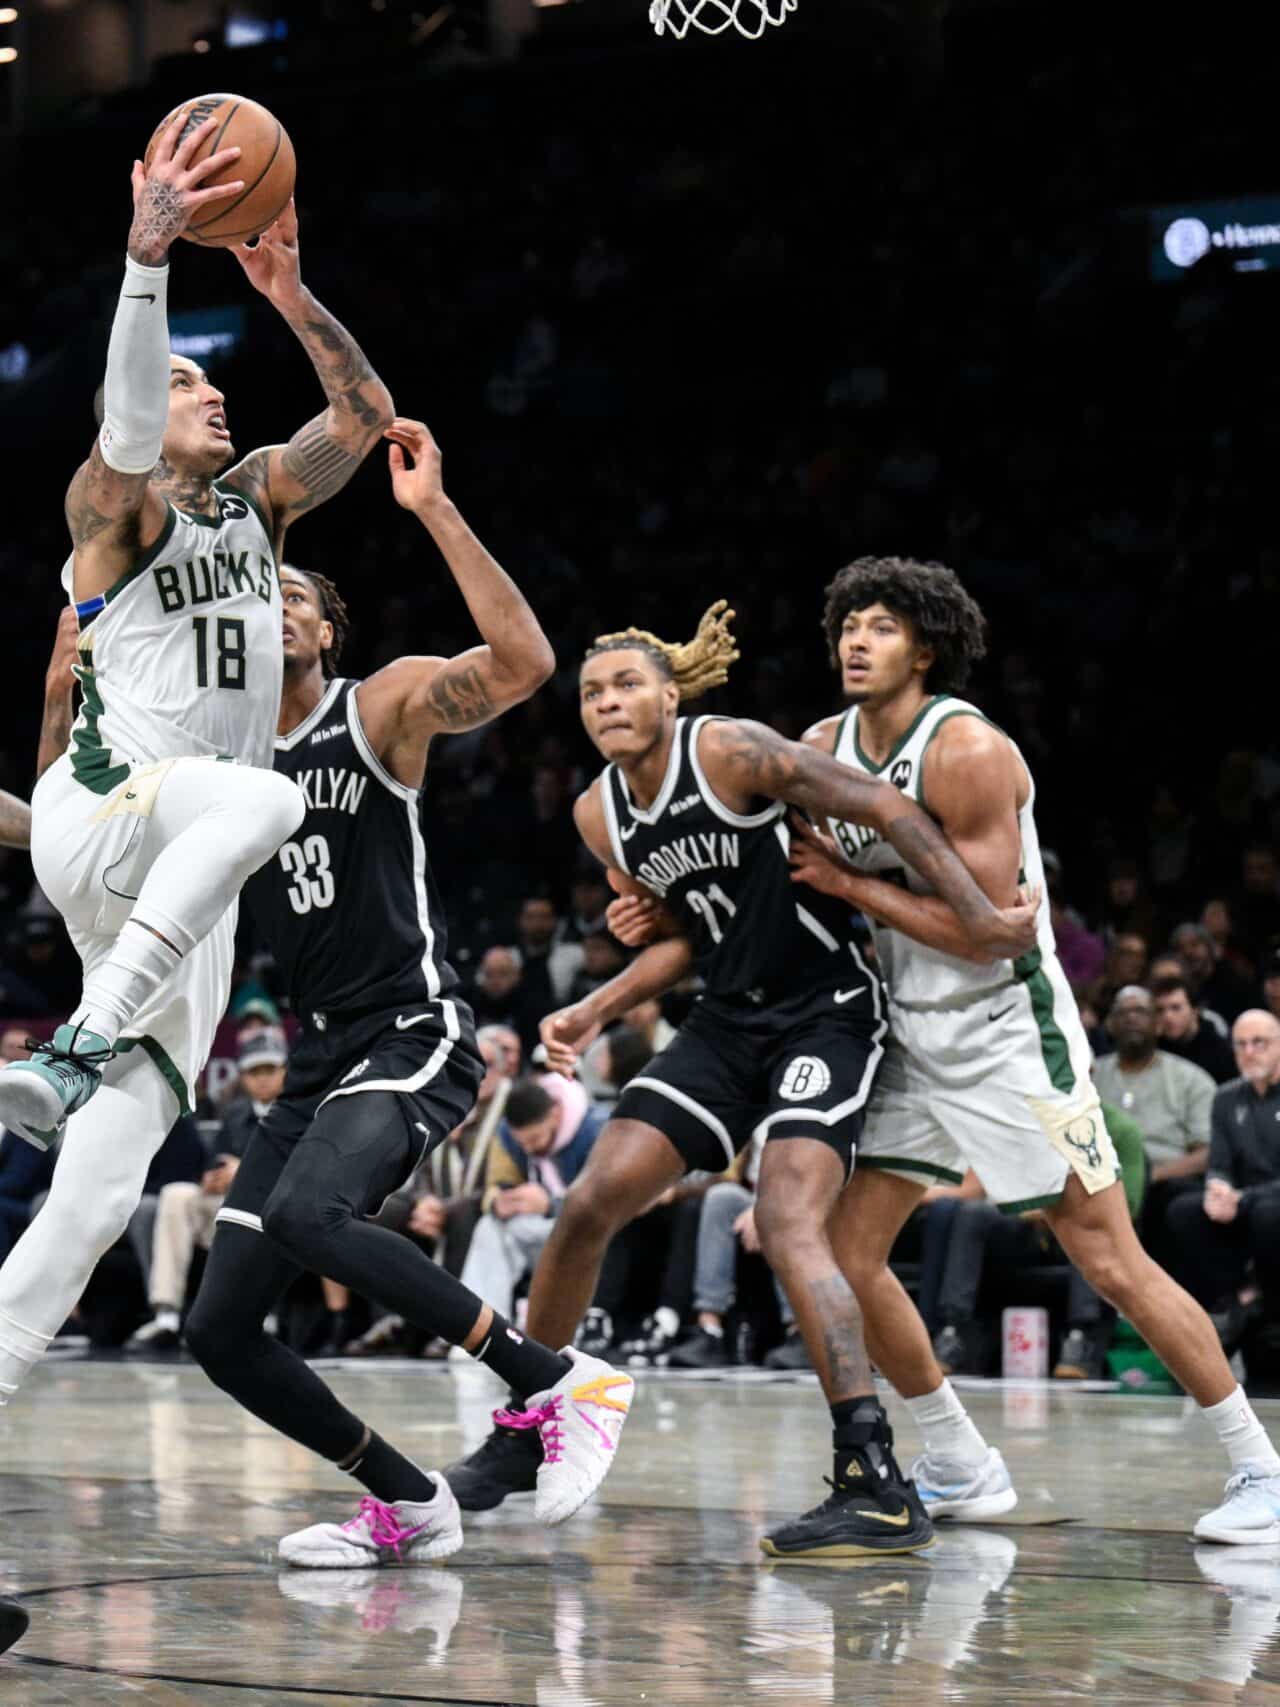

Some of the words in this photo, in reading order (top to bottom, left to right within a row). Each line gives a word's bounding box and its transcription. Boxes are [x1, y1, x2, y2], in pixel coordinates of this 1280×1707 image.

[153, 551, 271, 614] BUCKS
[192, 616, 246, 690] 18
[296, 767, 368, 815] KLYN
[279, 834, 335, 914] 33
[636, 832, 739, 898] ROOKLYN
